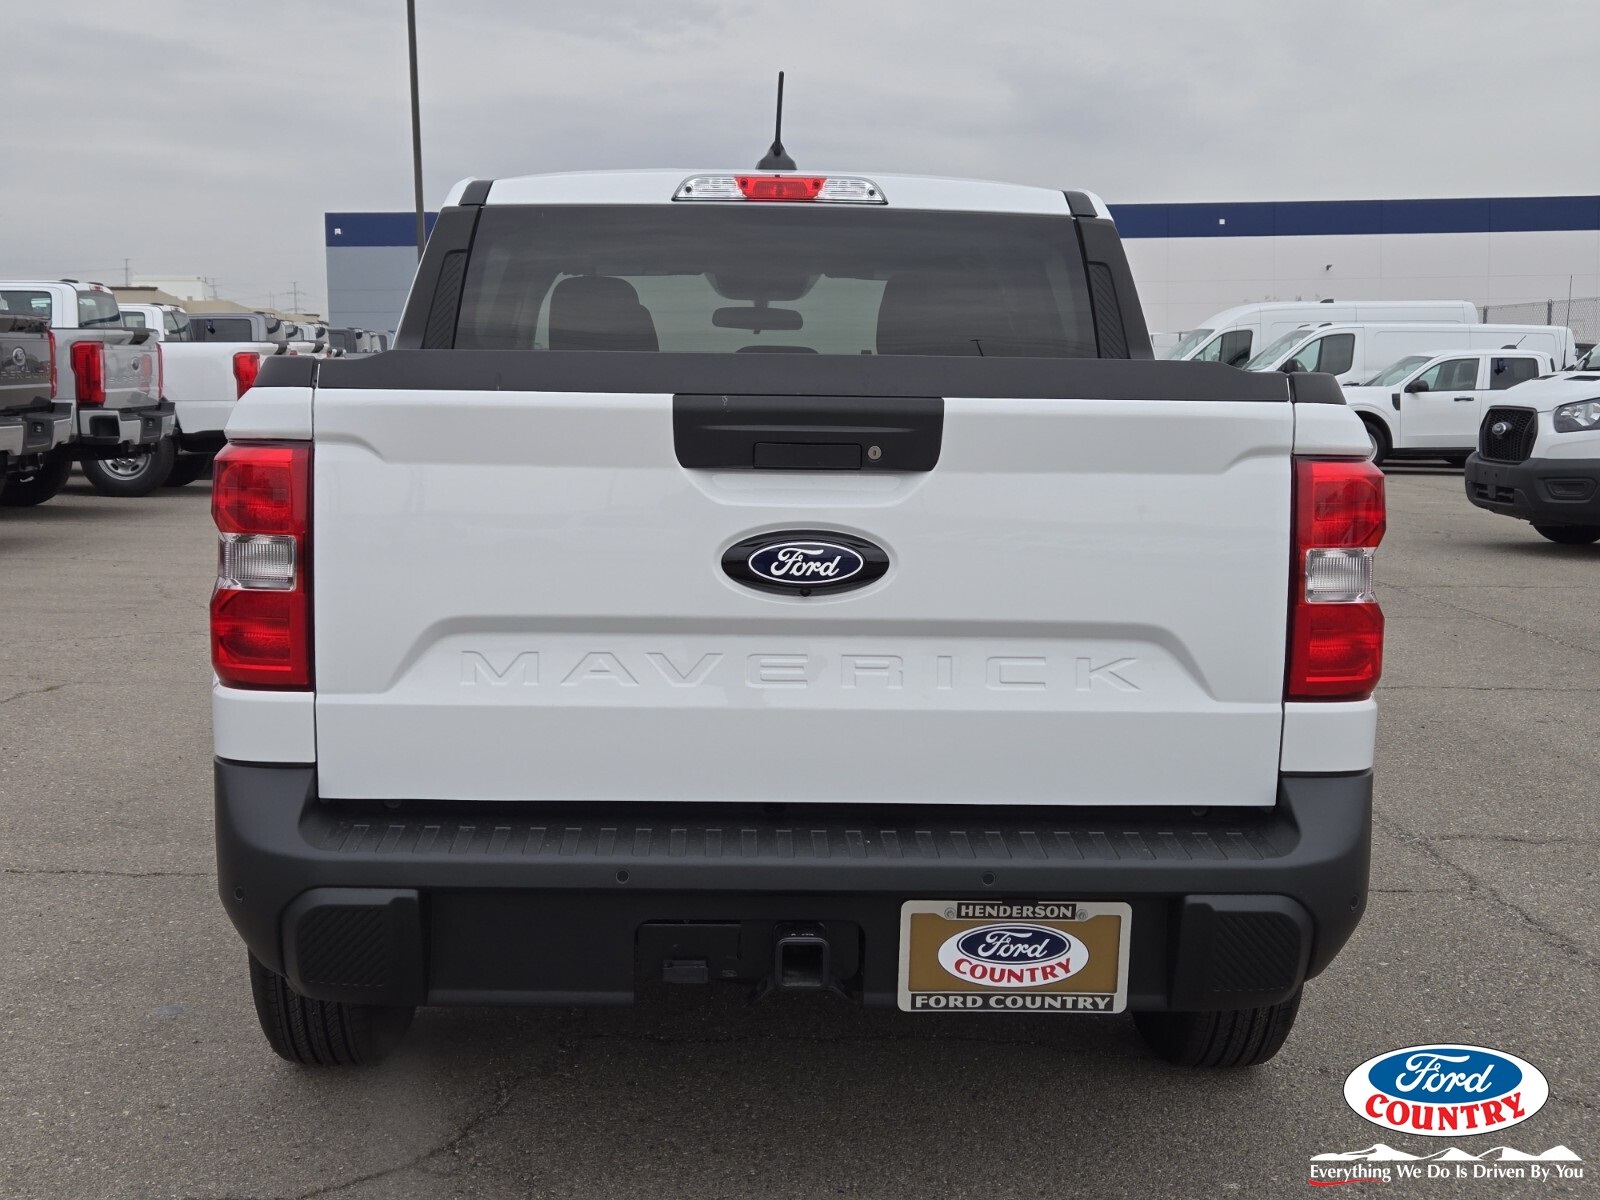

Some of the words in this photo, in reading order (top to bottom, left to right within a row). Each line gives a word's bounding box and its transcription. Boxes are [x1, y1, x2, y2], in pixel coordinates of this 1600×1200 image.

[770, 547, 841, 577] Ford
[460, 650, 1143, 692] MAVERICK
[960, 904, 1073, 919] HENDERSON
[977, 930, 1050, 958] Ford
[954, 957, 1072, 984] COUNTRY
[915, 995, 984, 1009] FORD
[988, 995, 1111, 1010] COUNTRY
